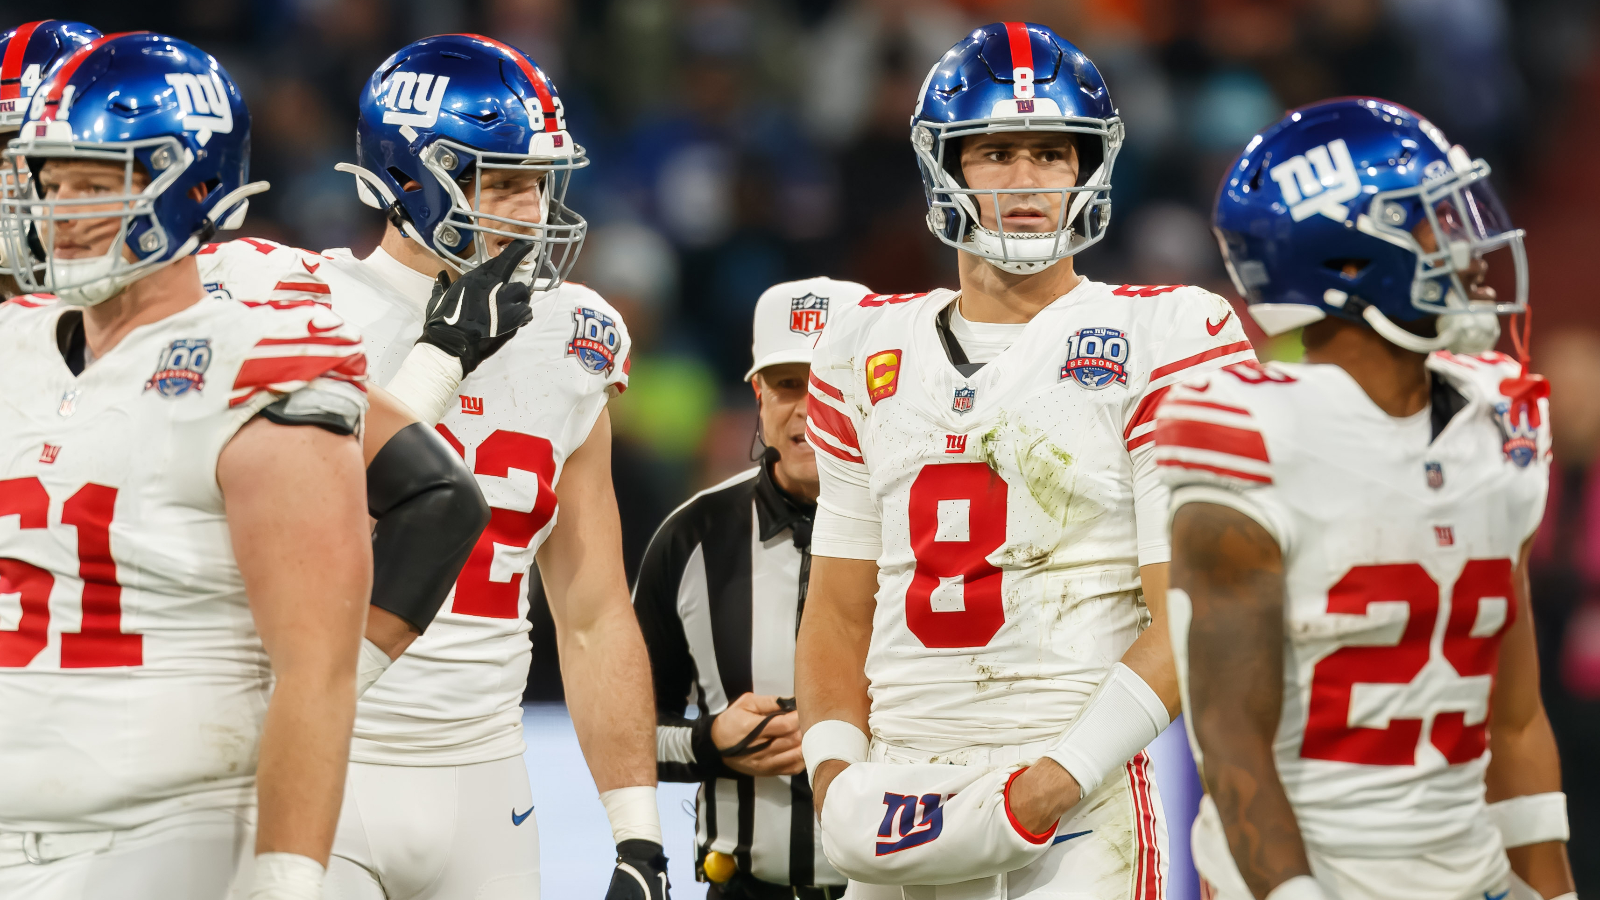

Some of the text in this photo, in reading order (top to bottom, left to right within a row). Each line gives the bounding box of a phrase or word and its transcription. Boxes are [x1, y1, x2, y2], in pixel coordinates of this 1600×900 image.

[382, 71, 450, 128] ny
[1011, 67, 1034, 99] 8
[165, 73, 233, 134] ny
[526, 97, 566, 131] 82
[1270, 138, 1360, 223] ny
[574, 313, 621, 355] 100
[791, 311, 825, 332] NFL
[157, 345, 212, 376] 100
[1067, 336, 1129, 364] 100
[1069, 358, 1120, 372] SEASONS
[867, 353, 897, 391] C
[954, 398, 971, 410] NFL
[945, 434, 969, 453] ny
[435, 424, 559, 619] 2
[906, 462, 1008, 649] 8
[1300, 558, 1516, 766] 29
